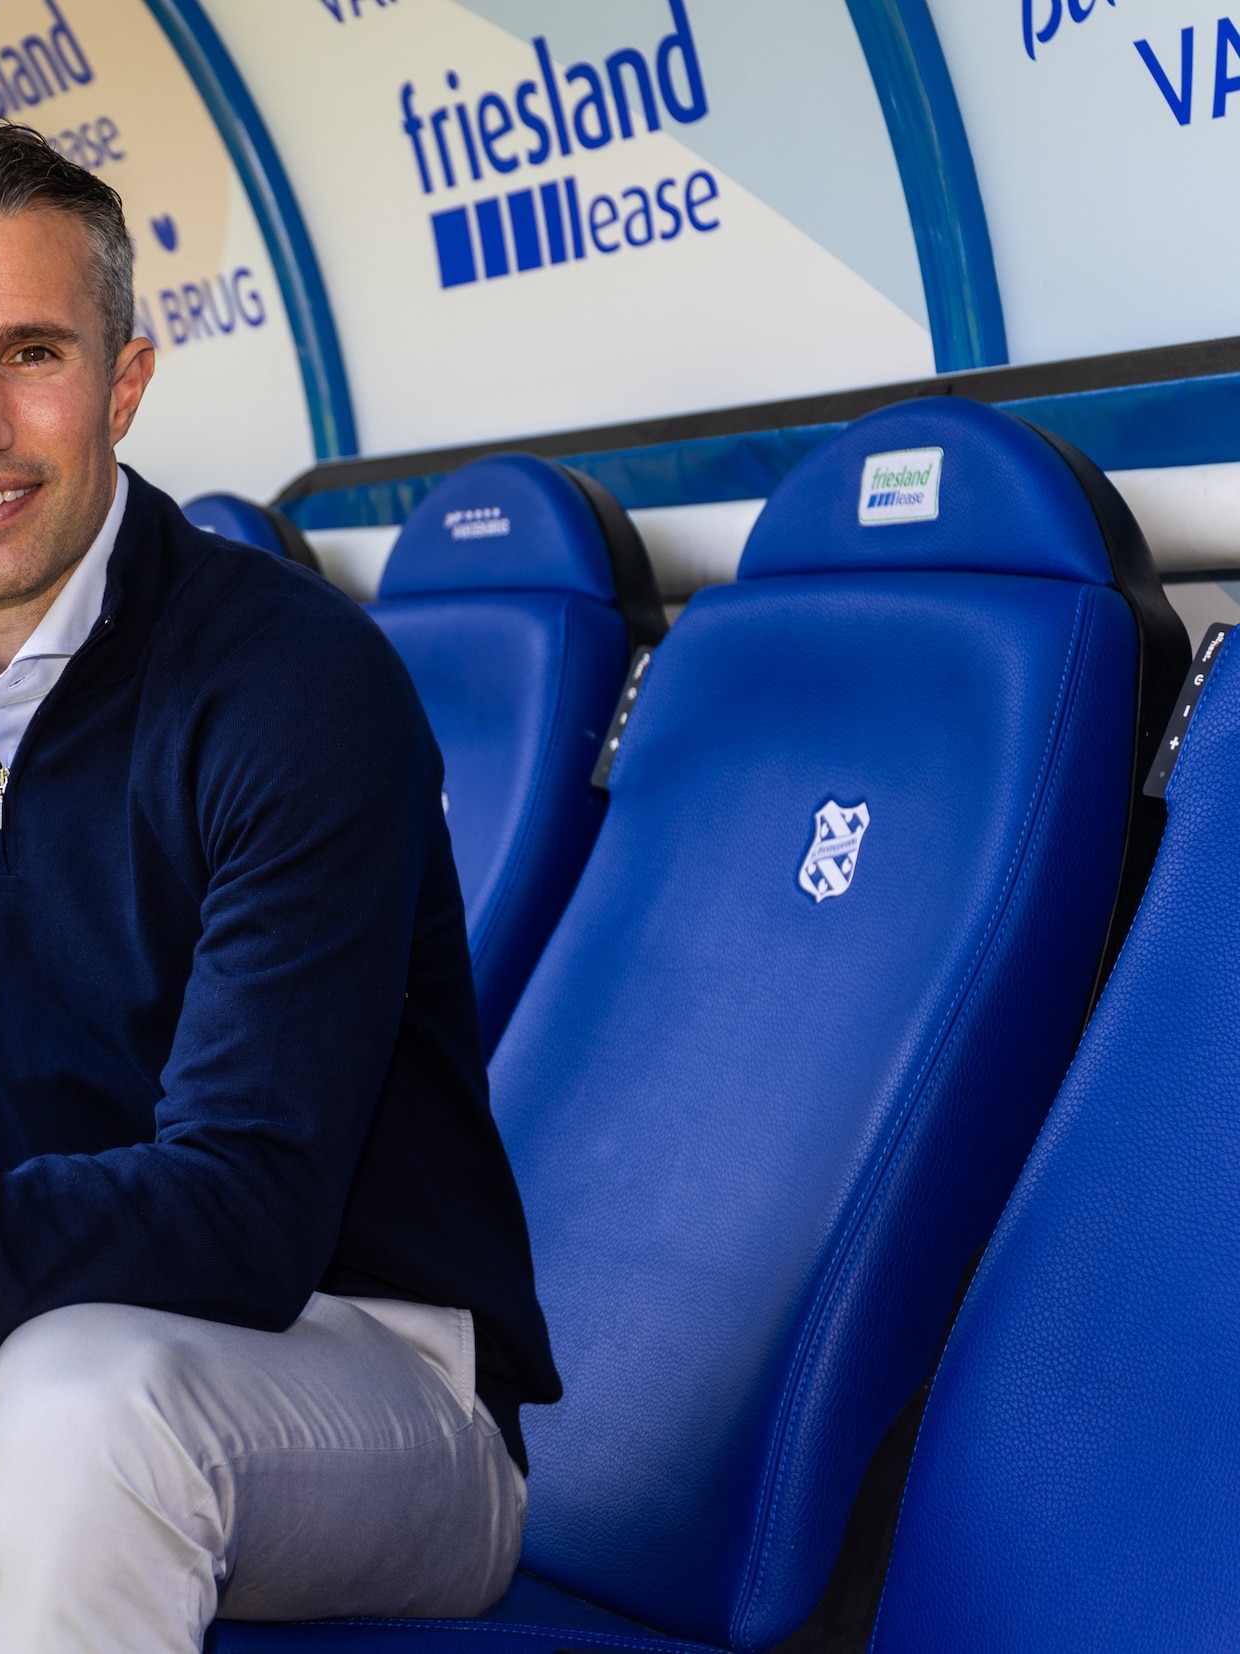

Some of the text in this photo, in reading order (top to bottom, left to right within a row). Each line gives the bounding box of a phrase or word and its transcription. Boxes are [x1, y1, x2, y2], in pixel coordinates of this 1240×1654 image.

[399, 0, 709, 194] friesland
[563, 168, 722, 260] lease
[159, 267, 266, 346] BRUG
[871, 463, 934, 490] friesland
[894, 490, 925, 506] lease
